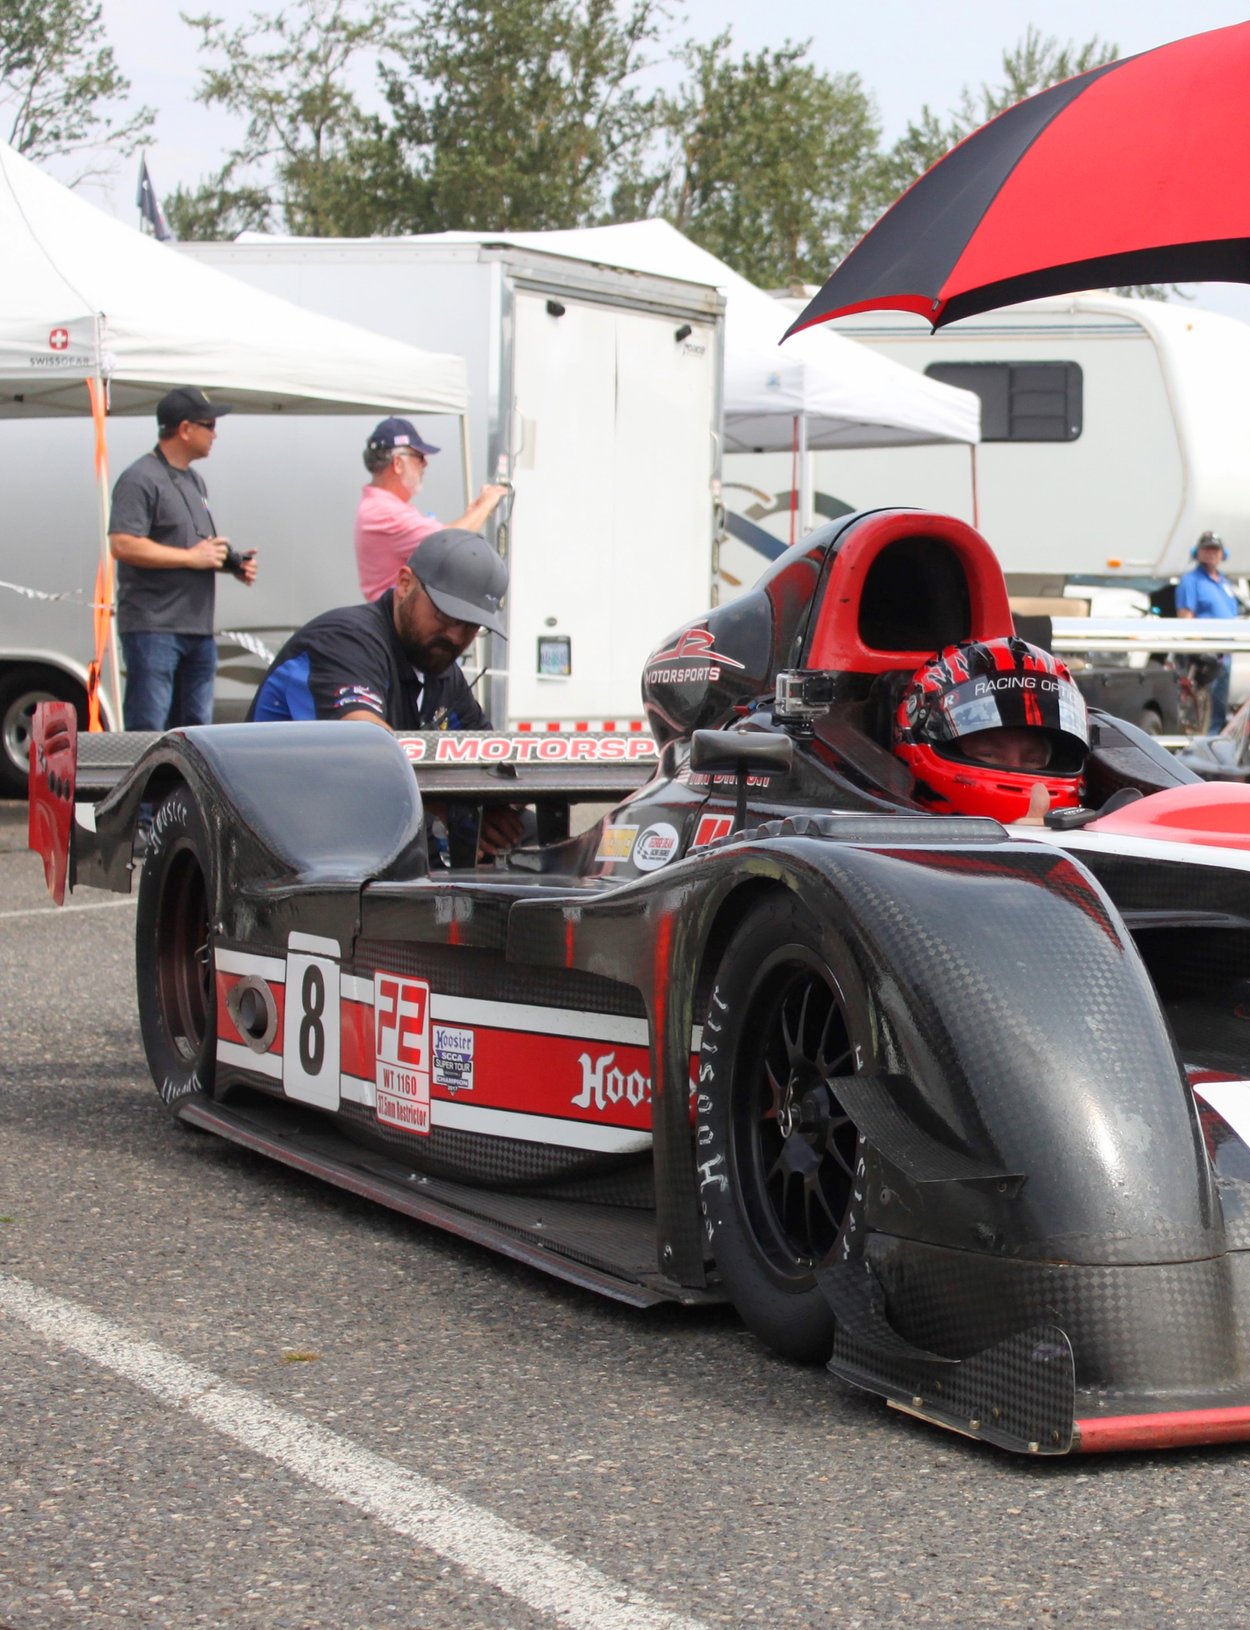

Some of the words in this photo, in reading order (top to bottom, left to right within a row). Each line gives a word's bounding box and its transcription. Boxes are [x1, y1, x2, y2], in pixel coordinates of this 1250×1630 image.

[645, 667, 721, 684] MOTORSPORTS
[974, 676, 1036, 696] RACING
[435, 737, 661, 761] MOTORSP
[299, 964, 325, 1077] 8
[441, 1052, 463, 1062] SCCA
[383, 1067, 395, 1090] WT
[397, 1073, 417, 1096] 1160
[570, 1051, 652, 1111] Hoo
